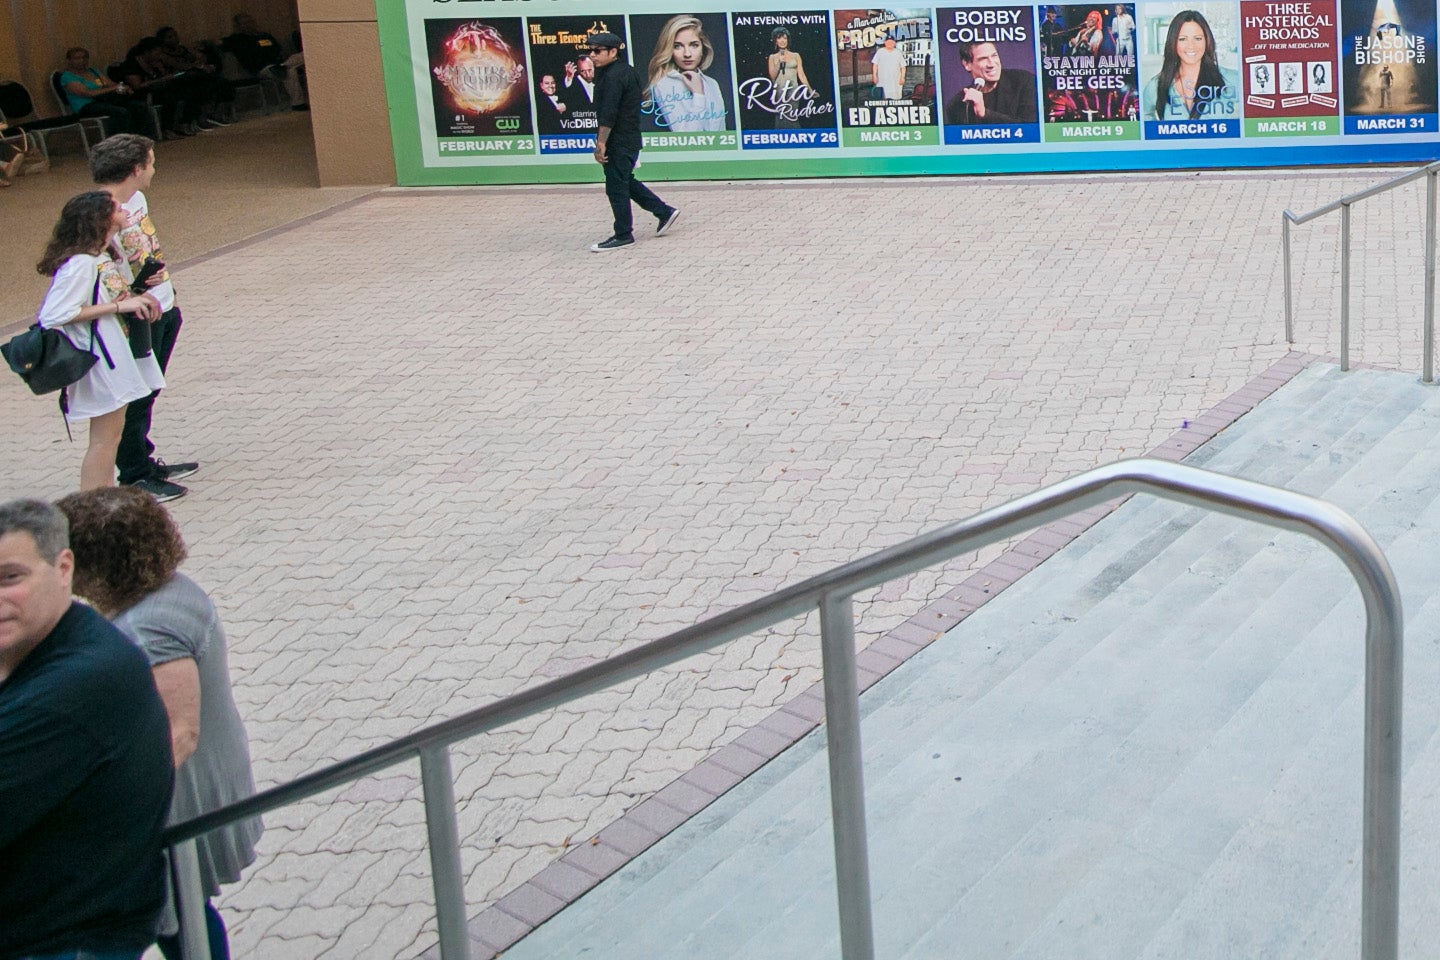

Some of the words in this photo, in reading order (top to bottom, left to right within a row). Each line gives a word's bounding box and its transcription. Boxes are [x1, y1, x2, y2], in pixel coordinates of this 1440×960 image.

[1265, 3, 1312, 15] THREE
[736, 17, 752, 25] AN
[754, 16, 798, 25] EVENING
[801, 15, 826, 24] WITH
[854, 17, 869, 28] Man
[870, 14, 883, 24] and
[883, 12, 896, 23] his
[955, 10, 1021, 25] BOBBY
[1245, 15, 1333, 28] HYSTERICAL
[530, 24, 542, 33] THE
[837, 17, 931, 50] PROSTATE
[946, 26, 1027, 43] COLLINS
[1260, 28, 1320, 40] BROADS
[531, 32, 557, 44] Three
[558, 31, 588, 44] Tenors
[1355, 35, 1363, 52] THE
[1363, 35, 1416, 50] JASON
[1416, 35, 1426, 64] SHOW
[1043, 55, 1095, 69] STAYIN
[1098, 54, 1135, 68] ALIVE
[1355, 50, 1416, 65] BISHOP
[1069, 68, 1097, 76] NIGHT
[1056, 76, 1084, 90] BEE
[1087, 75, 1126, 89] GEES
[1182, 80, 1236, 100] Sara
[641, 85, 693, 114] Jackie
[739, 77, 816, 113] Rita
[776, 100, 834, 121] Rudner
[1169, 95, 1235, 116] Evans
[654, 102, 729, 127] Evancho
[849, 107, 870, 126] ED
[875, 106, 931, 125] ASNER
[1062, 126, 1111, 137] MARCH
[1115, 125, 1123, 135] 9
[1158, 124, 1207, 135] MARCH
[1211, 123, 1227, 133] 16
[1258, 122, 1307, 132] MARCH
[1311, 121, 1326, 131] 18
[1357, 119, 1406, 130] MARCH
[1409, 118, 1425, 128] 31
[642, 136, 716, 147] FEBRUARY
[719, 135, 736, 145] 25
[743, 133, 817, 144] FEBRUARY
[821, 133, 837, 143] 26
[860, 131, 910, 142] MARCH
[914, 131, 922, 140] 3
[961, 129, 1011, 139] MARCH
[1014, 128, 1023, 138] 4
[440, 141, 513, 152] FEBRUARY
[517, 140, 534, 150] 23
